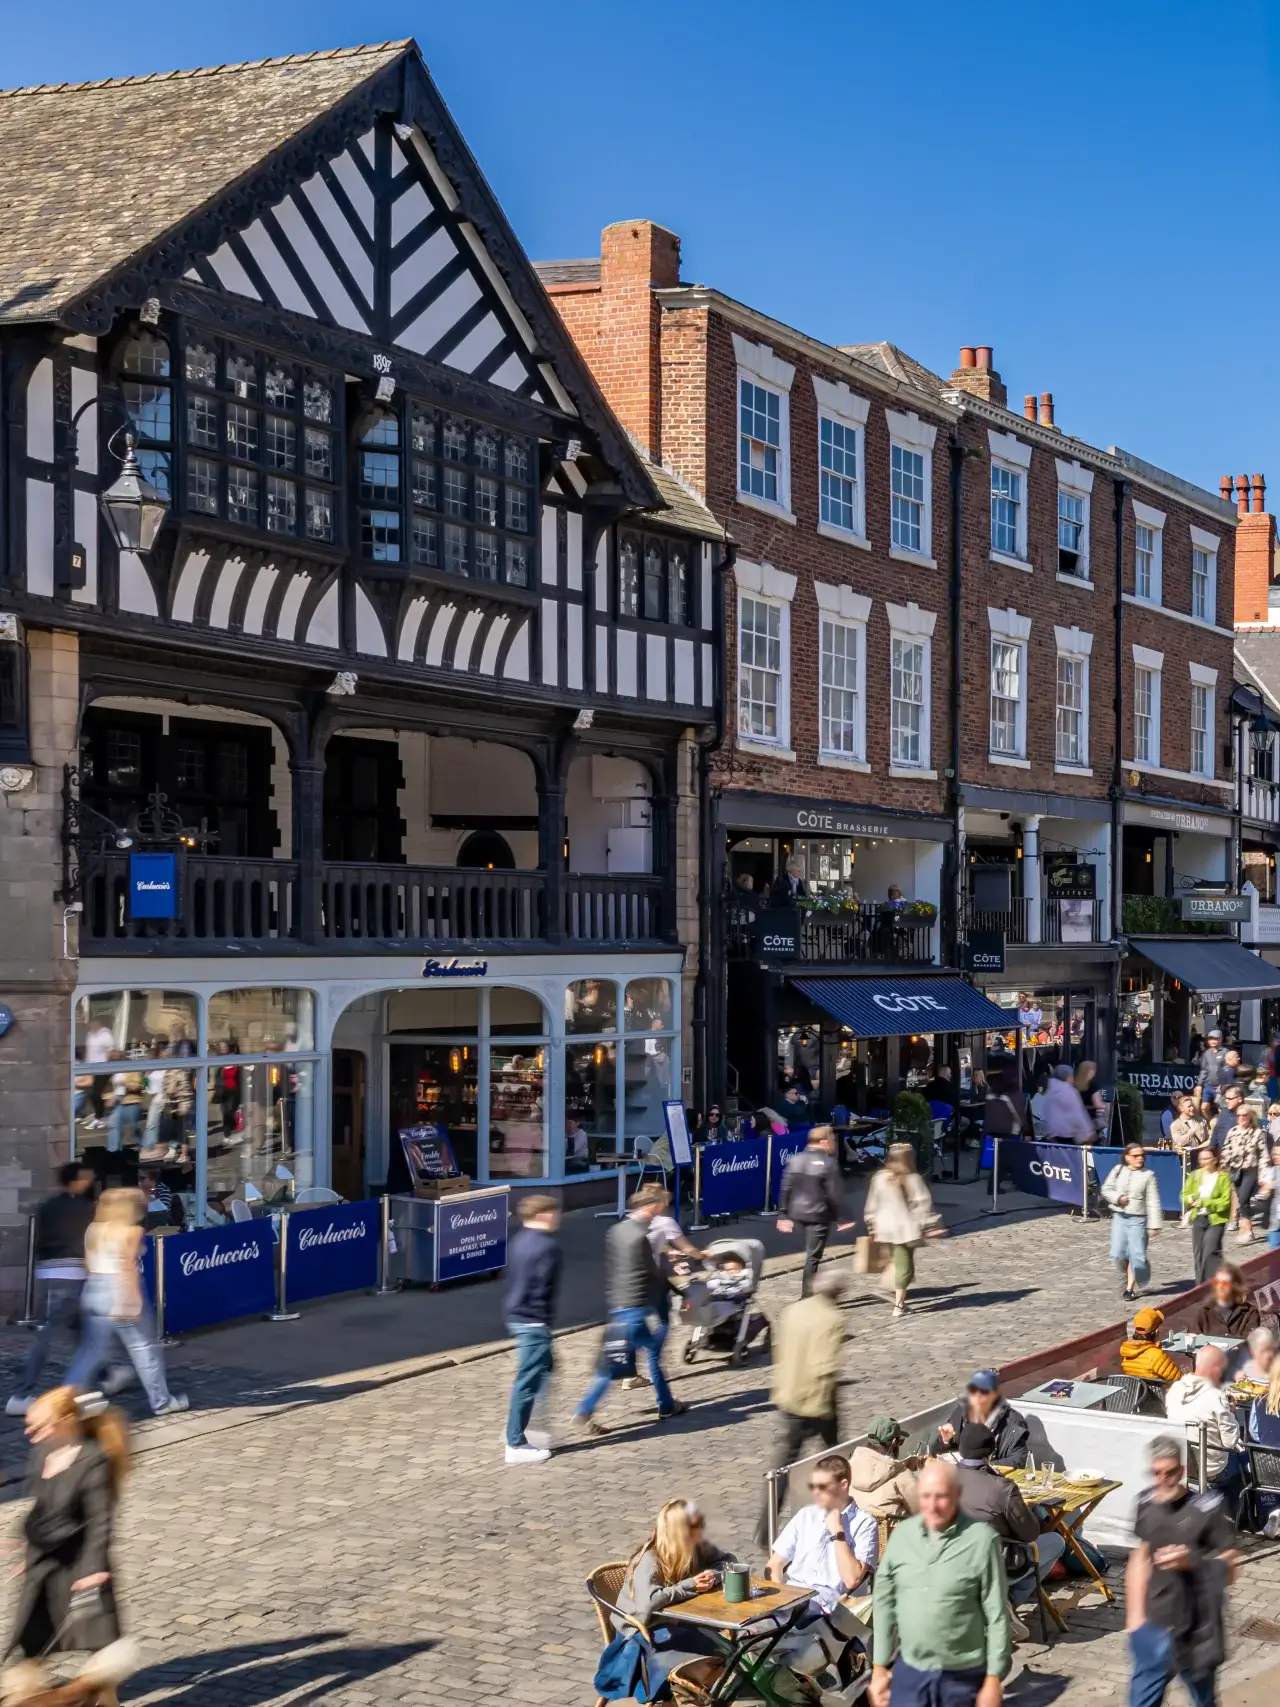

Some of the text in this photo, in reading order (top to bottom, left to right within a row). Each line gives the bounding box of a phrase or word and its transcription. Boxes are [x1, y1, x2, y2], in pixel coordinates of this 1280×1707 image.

[74, 556, 80, 566] 7
[796, 810, 889, 834] CÔTE BRASSERIE
[136, 881, 171, 891] Carluccio's
[763, 935, 795, 946] CÔTE
[973, 953, 1001, 963] CÔTE
[873, 993, 949, 1011] CÔTE
[711, 1154, 759, 1177] Carluccio's
[1029, 1161, 1072, 1182] CÔTE
[450, 1209, 498, 1229] Carluccio's
[299, 1220, 366, 1251] Carluccio's
[460, 1236, 475, 1244] OPEN
[449, 1239, 498, 1255] BREAKFAST, LUNCH
[466, 1249, 486, 1259] DINNER
[180, 1240, 260, 1276] Carluccio's
